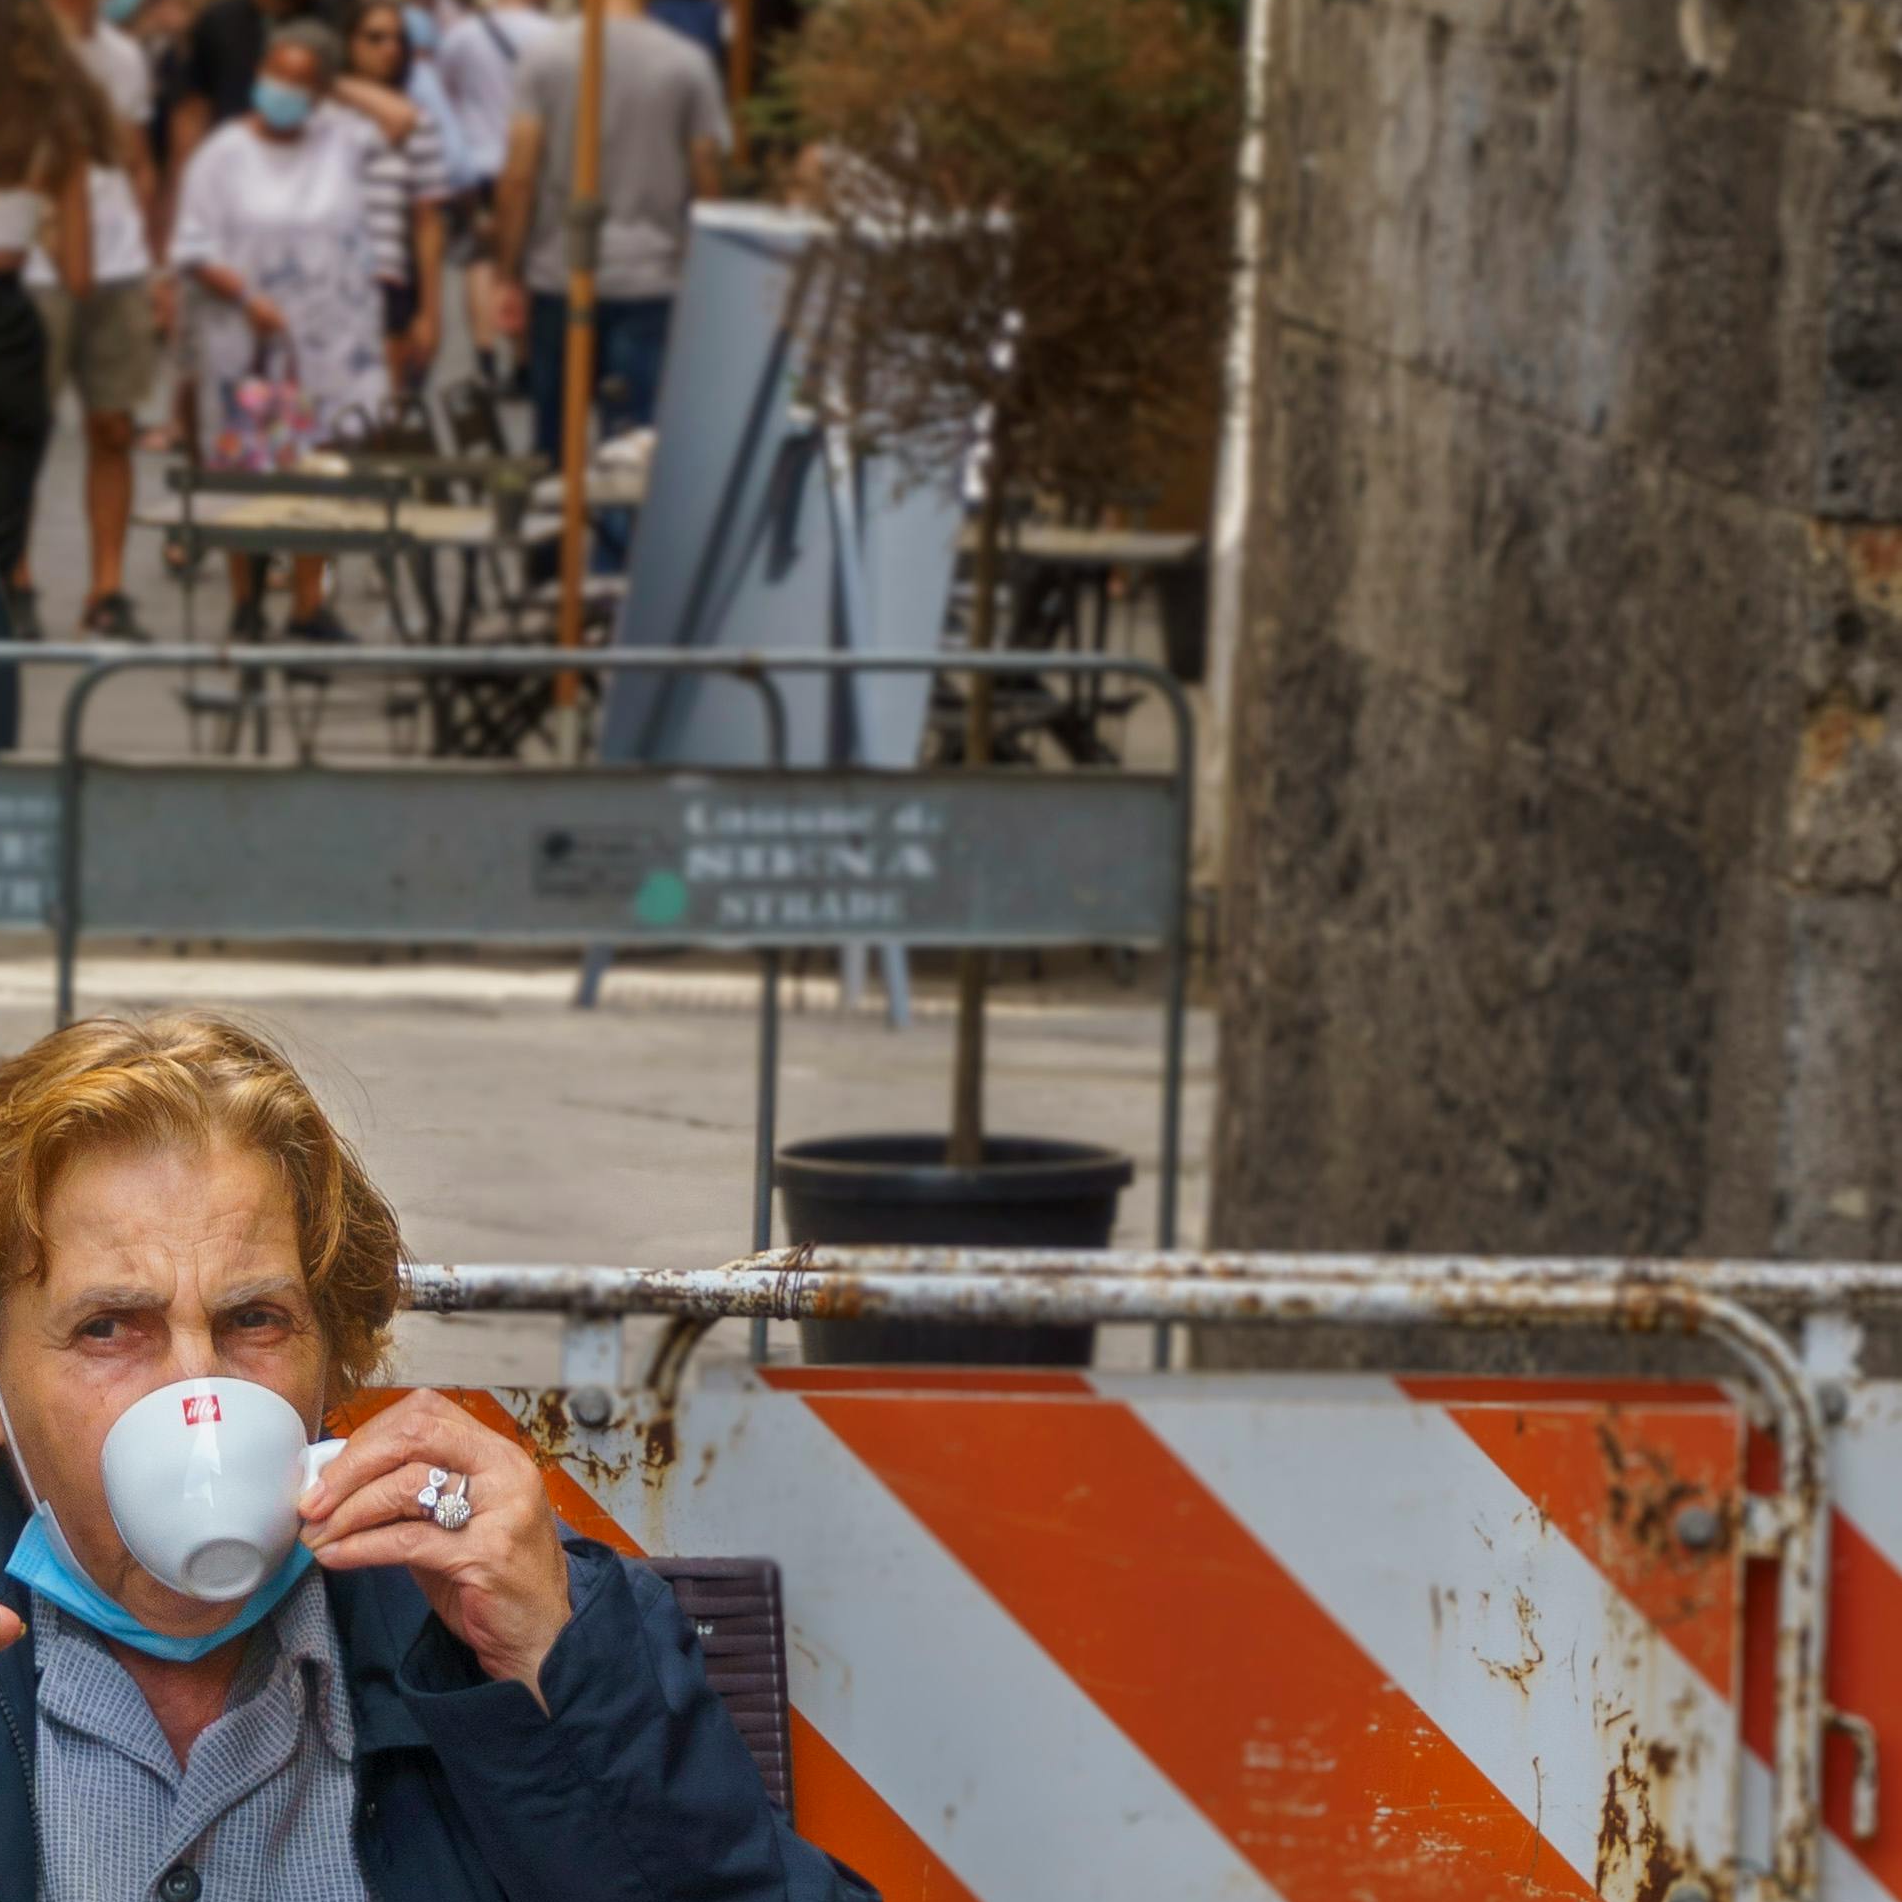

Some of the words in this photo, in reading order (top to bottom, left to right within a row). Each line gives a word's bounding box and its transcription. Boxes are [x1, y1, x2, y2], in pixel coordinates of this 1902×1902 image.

[685, 843, 937, 880] SIENA
[717, 891, 904, 926] STRADE
[187, 1396, 218, 1422] illy
